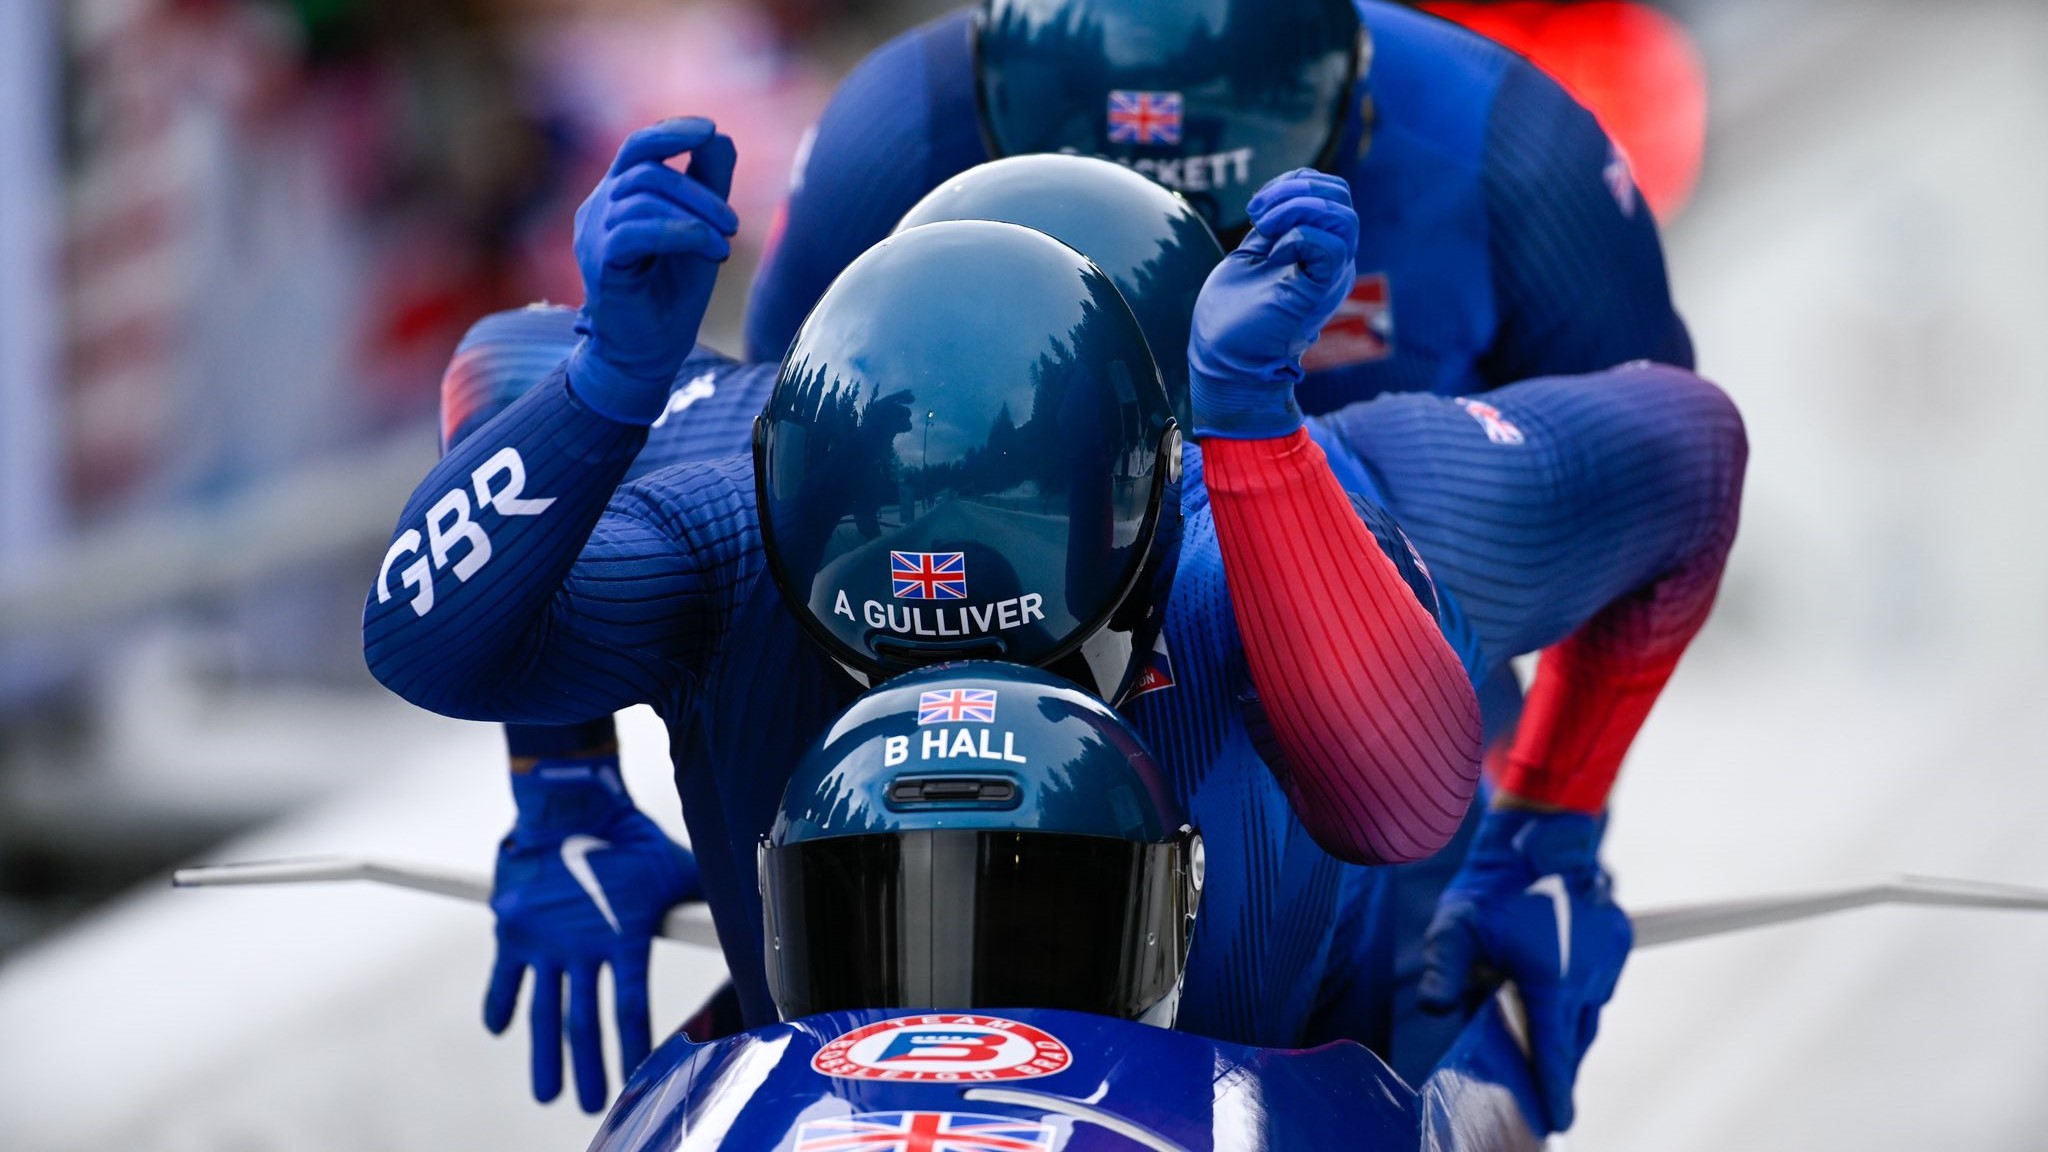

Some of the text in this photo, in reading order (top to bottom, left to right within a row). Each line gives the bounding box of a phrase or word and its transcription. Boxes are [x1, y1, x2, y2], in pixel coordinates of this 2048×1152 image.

[1092, 148, 1252, 191] CKETT
[378, 447, 557, 617] GBR
[834, 590, 1045, 636] A GULLIVER
[884, 729, 1027, 767] B HALL
[886, 1016, 1016, 1030] TEAM
[818, 1040, 1066, 1080] BOBSLEIGH BRAD
